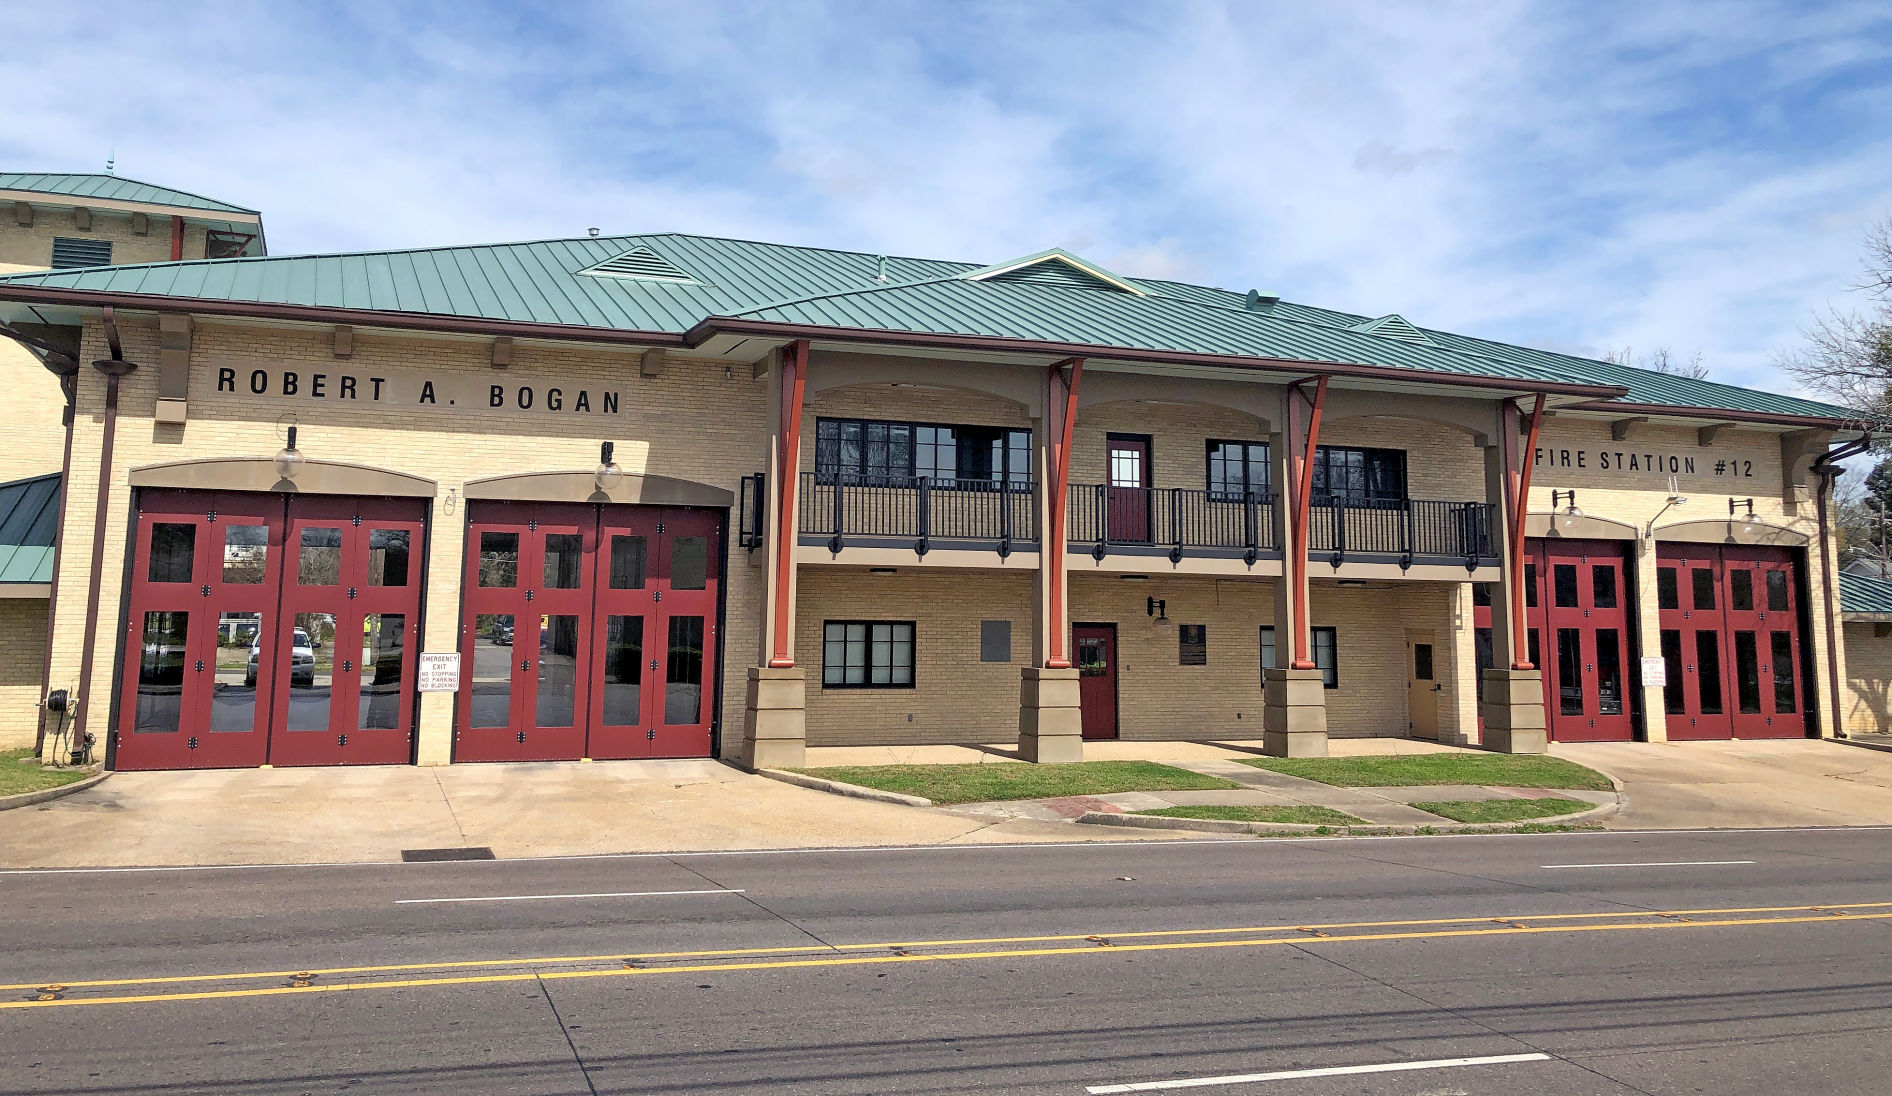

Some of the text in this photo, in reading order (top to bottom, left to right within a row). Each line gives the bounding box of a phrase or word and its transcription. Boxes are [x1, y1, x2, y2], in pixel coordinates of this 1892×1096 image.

[217, 367, 619, 414] ROBERT A. BOGAN
[1534, 447, 1753, 477] FIRE STATION #12
